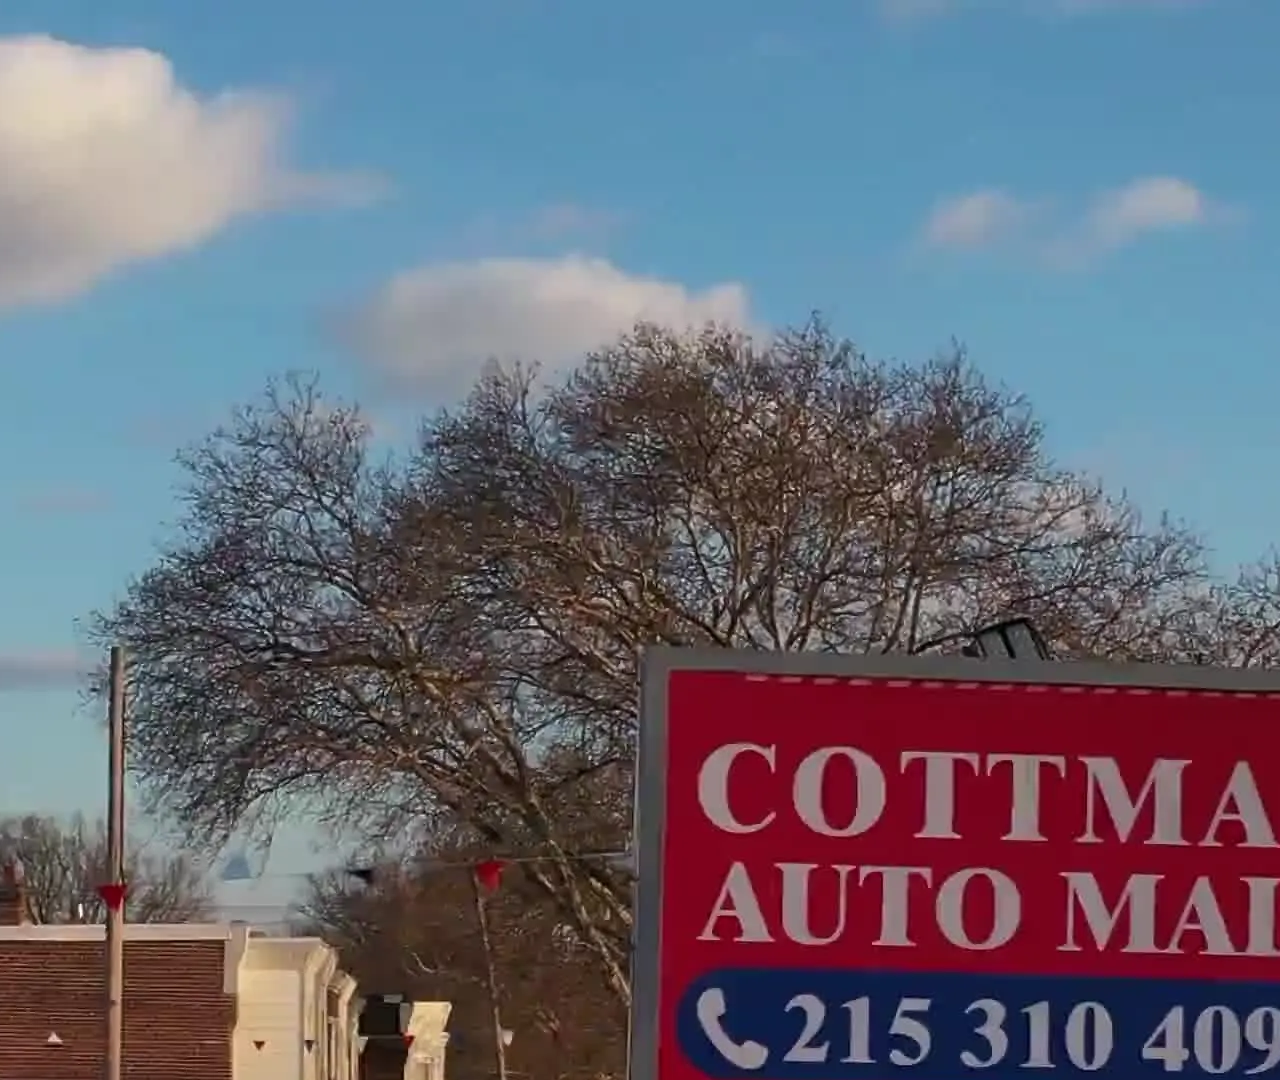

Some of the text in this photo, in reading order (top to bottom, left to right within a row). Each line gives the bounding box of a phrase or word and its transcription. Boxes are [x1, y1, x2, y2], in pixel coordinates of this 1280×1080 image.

[696, 861, 1021, 951] AUTO
[782, 993, 932, 1066] 215
[960, 998, 1114, 1070] 310
